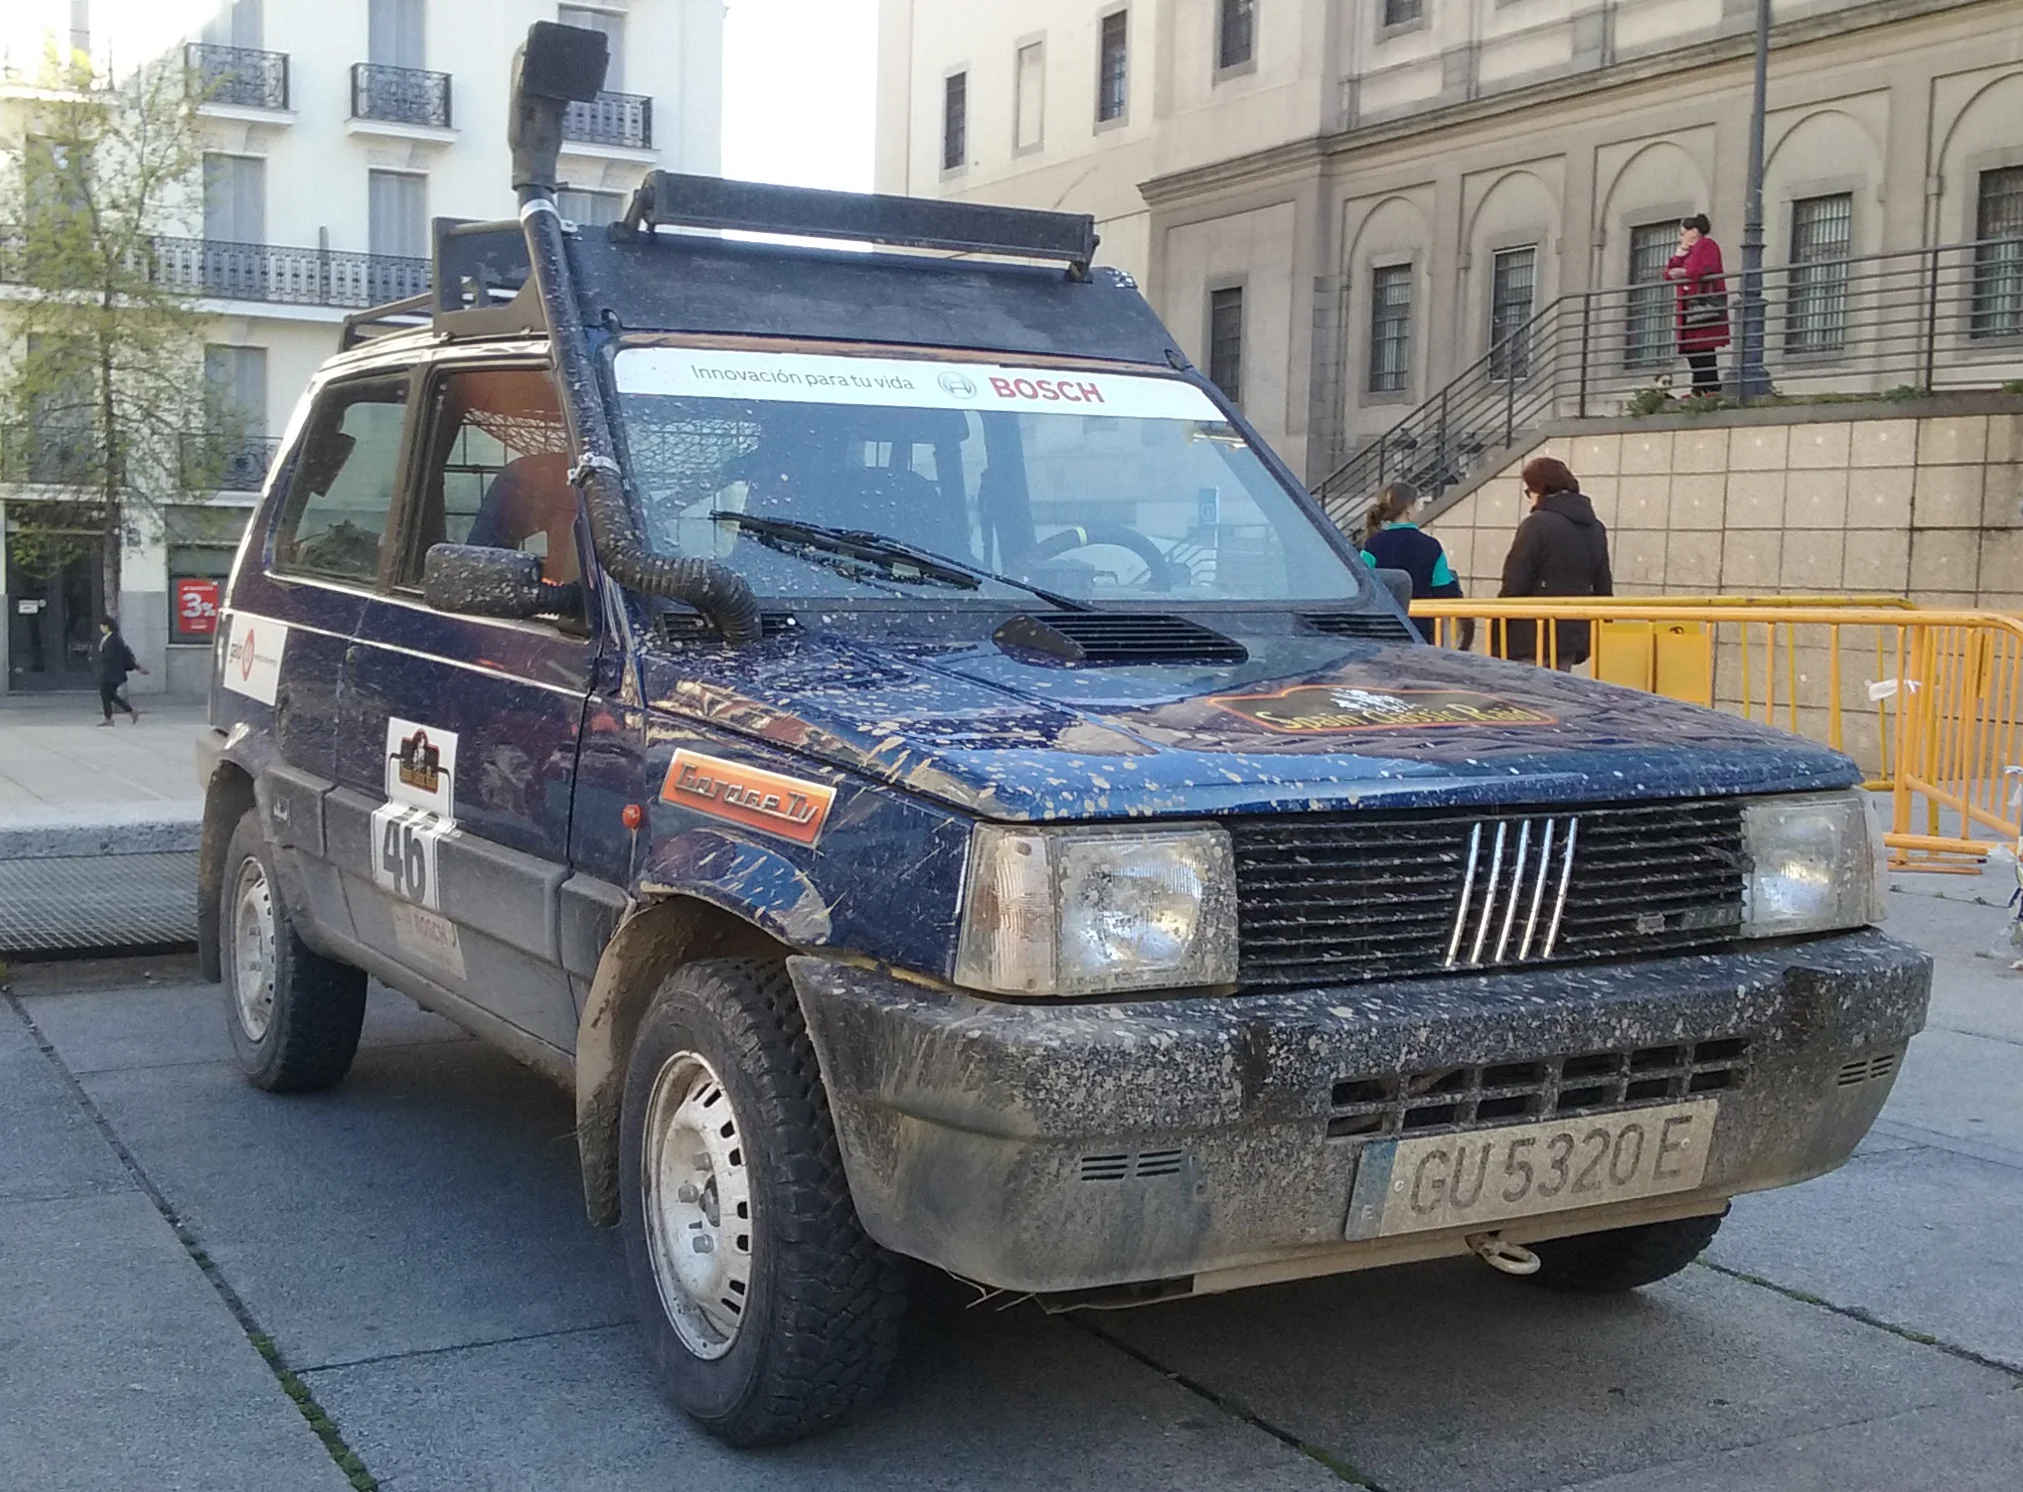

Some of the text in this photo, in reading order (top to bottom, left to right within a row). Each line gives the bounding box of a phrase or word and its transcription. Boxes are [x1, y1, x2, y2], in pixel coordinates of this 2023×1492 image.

[690, 364, 1106, 403] Innovación para tu vida BOSCH
[1254, 711, 1369, 732] Spain
[382, 806, 439, 904] 46
[1501, 1123, 1646, 1203] 5320
